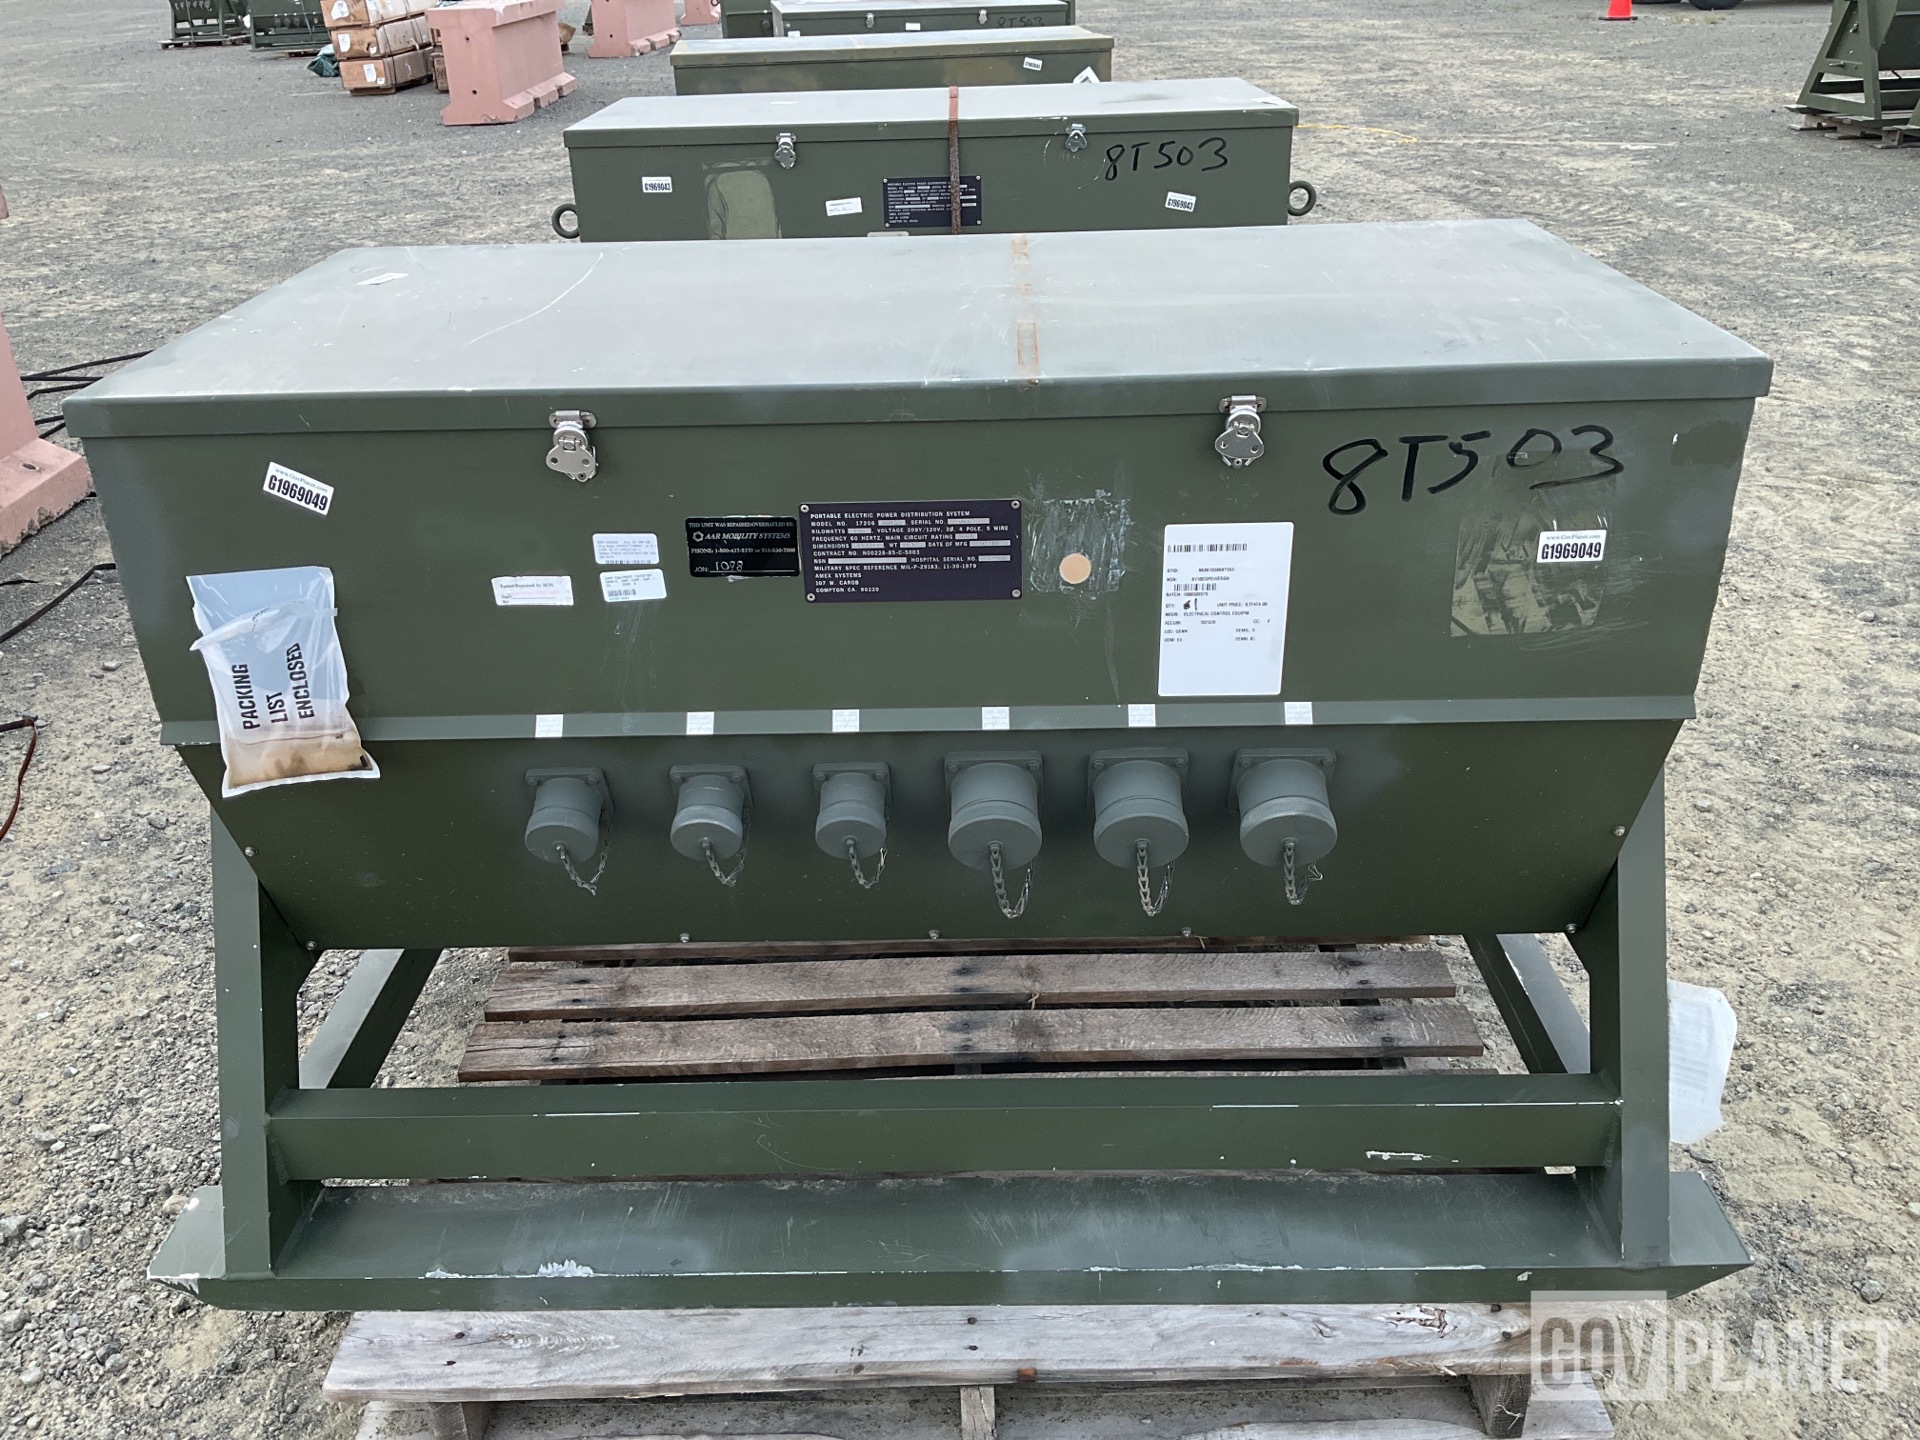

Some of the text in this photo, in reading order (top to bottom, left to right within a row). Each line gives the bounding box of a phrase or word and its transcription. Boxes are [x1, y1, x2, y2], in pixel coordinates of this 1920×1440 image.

[1105, 137, 1228, 180] 8T503
[1323, 425, 1624, 515] 8T503
[269, 475, 328, 510] G1969049
[1541, 542, 1601, 560] G1969049
[231, 664, 260, 730] PACKING
[286, 643, 315, 719] ENCLOSED
[266, 692, 288, 723] LIST
